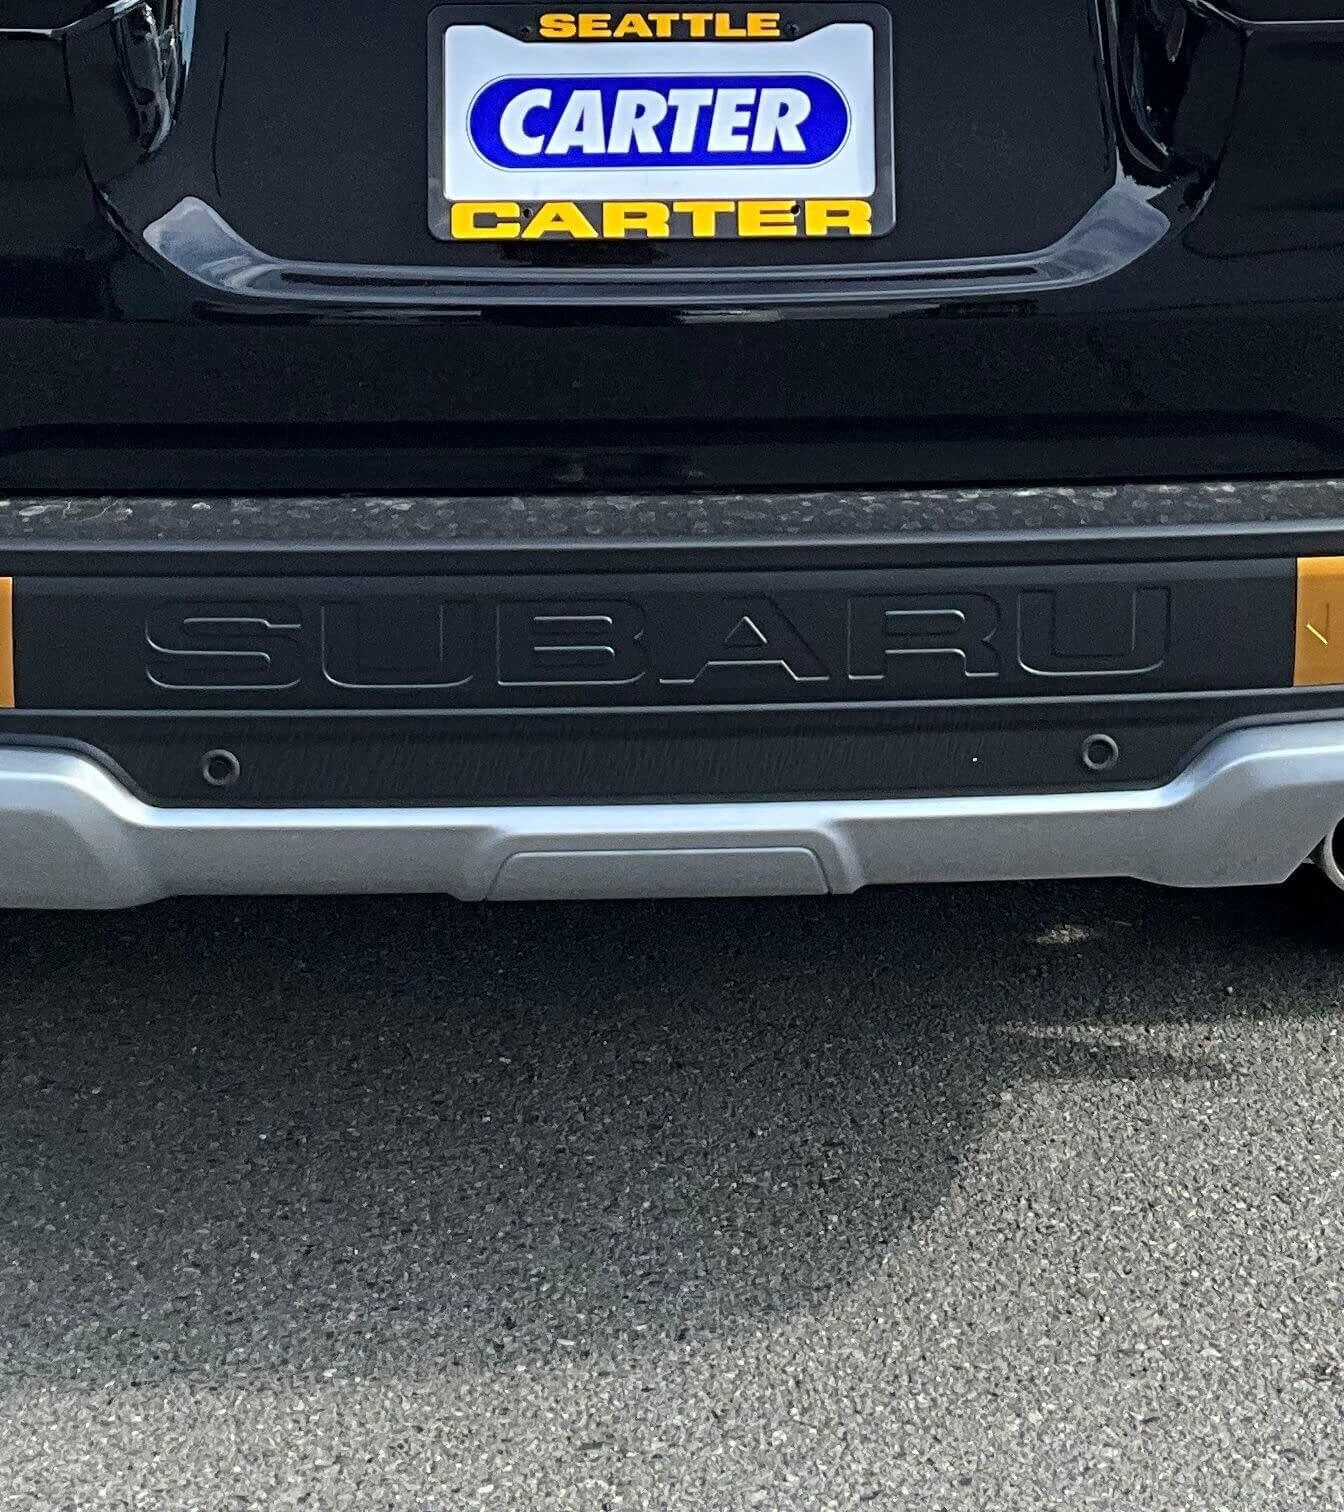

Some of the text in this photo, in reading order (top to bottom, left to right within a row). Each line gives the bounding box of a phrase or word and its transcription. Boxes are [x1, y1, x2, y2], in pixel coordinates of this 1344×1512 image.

[539, 12, 780, 39] SEATTLE
[498, 88, 811, 155] CARTER
[450, 200, 872, 239] CARTER
[144, 587, 1173, 690] SUBARU
